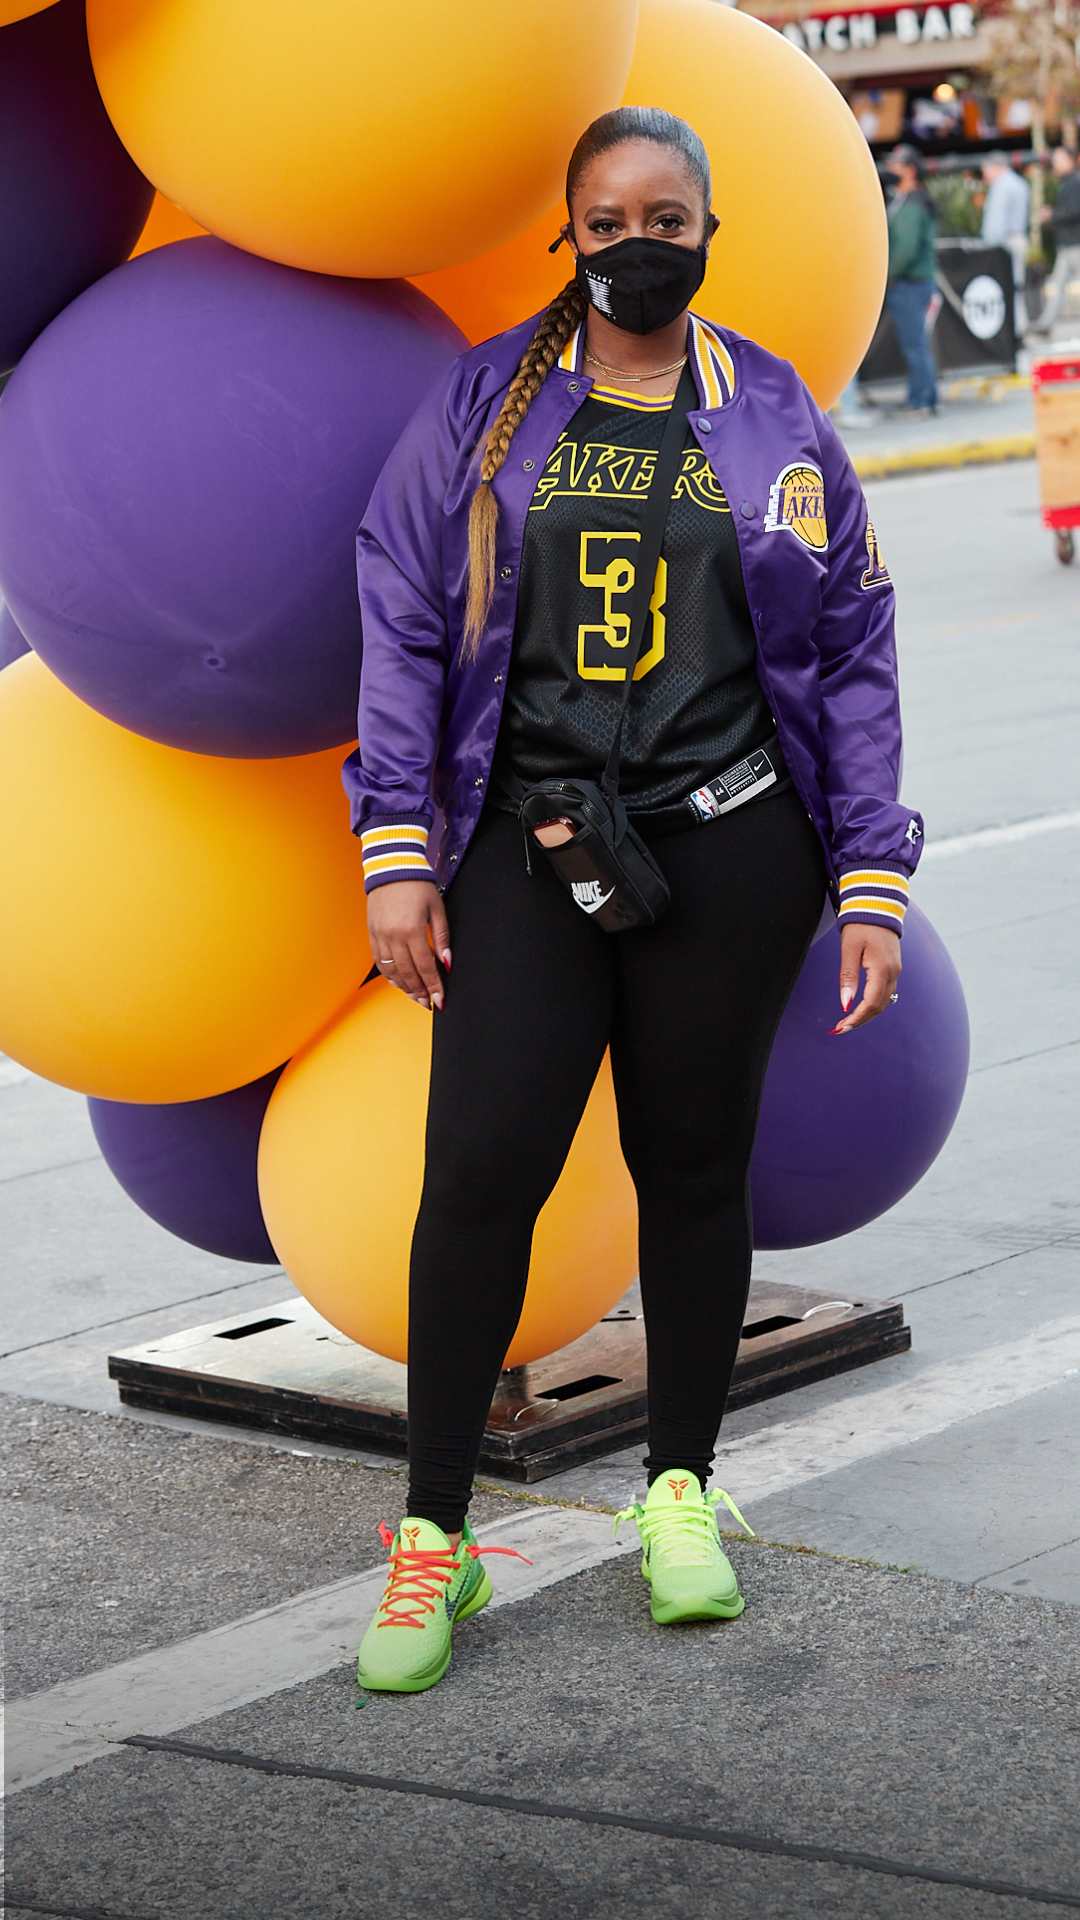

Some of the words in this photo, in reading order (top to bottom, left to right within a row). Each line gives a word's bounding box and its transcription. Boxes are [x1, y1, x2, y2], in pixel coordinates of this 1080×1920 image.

[895, 3, 976, 44] BAR
[577, 531, 668, 681] 3
[571, 880, 602, 903] NIKE
